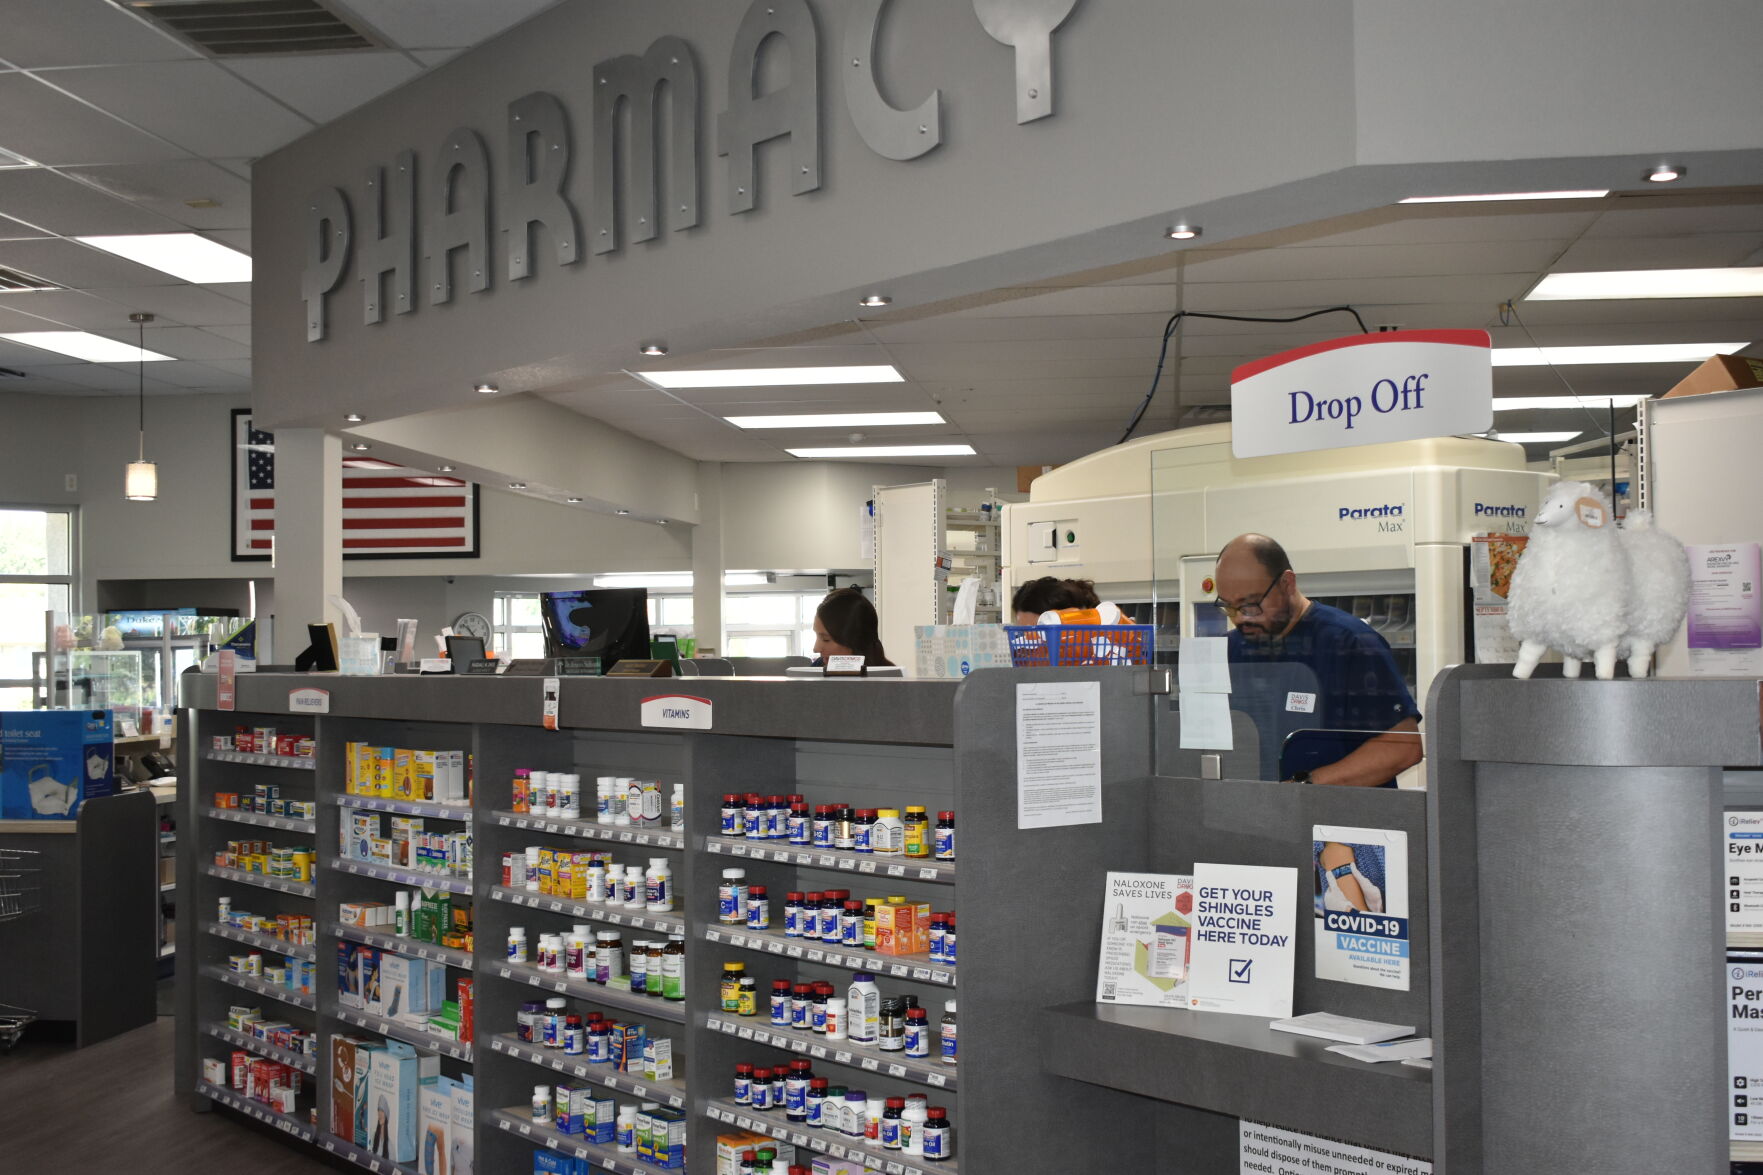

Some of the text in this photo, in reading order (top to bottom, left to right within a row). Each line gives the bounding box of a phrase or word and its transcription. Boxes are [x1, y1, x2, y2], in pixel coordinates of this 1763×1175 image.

[300, 0, 1083, 343] PHARMACY
[1288, 373, 1430, 430] Drop Off
[1339, 504, 1403, 521] Parata
[1474, 503, 1526, 518] Parata
[1377, 520, 1403, 533] Max
[1506, 521, 1526, 533] Max
[662, 709, 690, 719] VITAMINS
[4, 729, 42, 738] toilet seat
[1729, 843, 1751, 856] Eye
[1113, 879, 1166, 890] NALOXONE
[1112, 889, 1173, 899] SAVES LIVES
[1199, 887, 1273, 902] GET YOUR
[1198, 901, 1274, 917] SHINGLES
[1198, 915, 1261, 930] VACCINE
[1327, 914, 1399, 936] COVID-19
[1197, 930, 1288, 947] HERE TODAY
[1340, 936, 1400, 955] VACCINE
[1349, 954, 1400, 966] AVAILABLE HERE
[1732, 986, 1762, 1000] Per
[1243, 1130, 1252, 1139] or
[1253, 1131, 1302, 1151] intentionally
[1303, 1143, 1330, 1157] misuse
[1331, 1151, 1374, 1167] unneeded
[1375, 1160, 1385, 1168] or
[1386, 1163, 1419, 1175] expired
[1243, 1144, 1269, 1158] should
[1270, 1150, 1300, 1165] dispose
[1301, 1158, 1310, 1167] of
[1311, 1159, 1332, 1173] them
[1243, 1160, 1275, 1174] needed.
